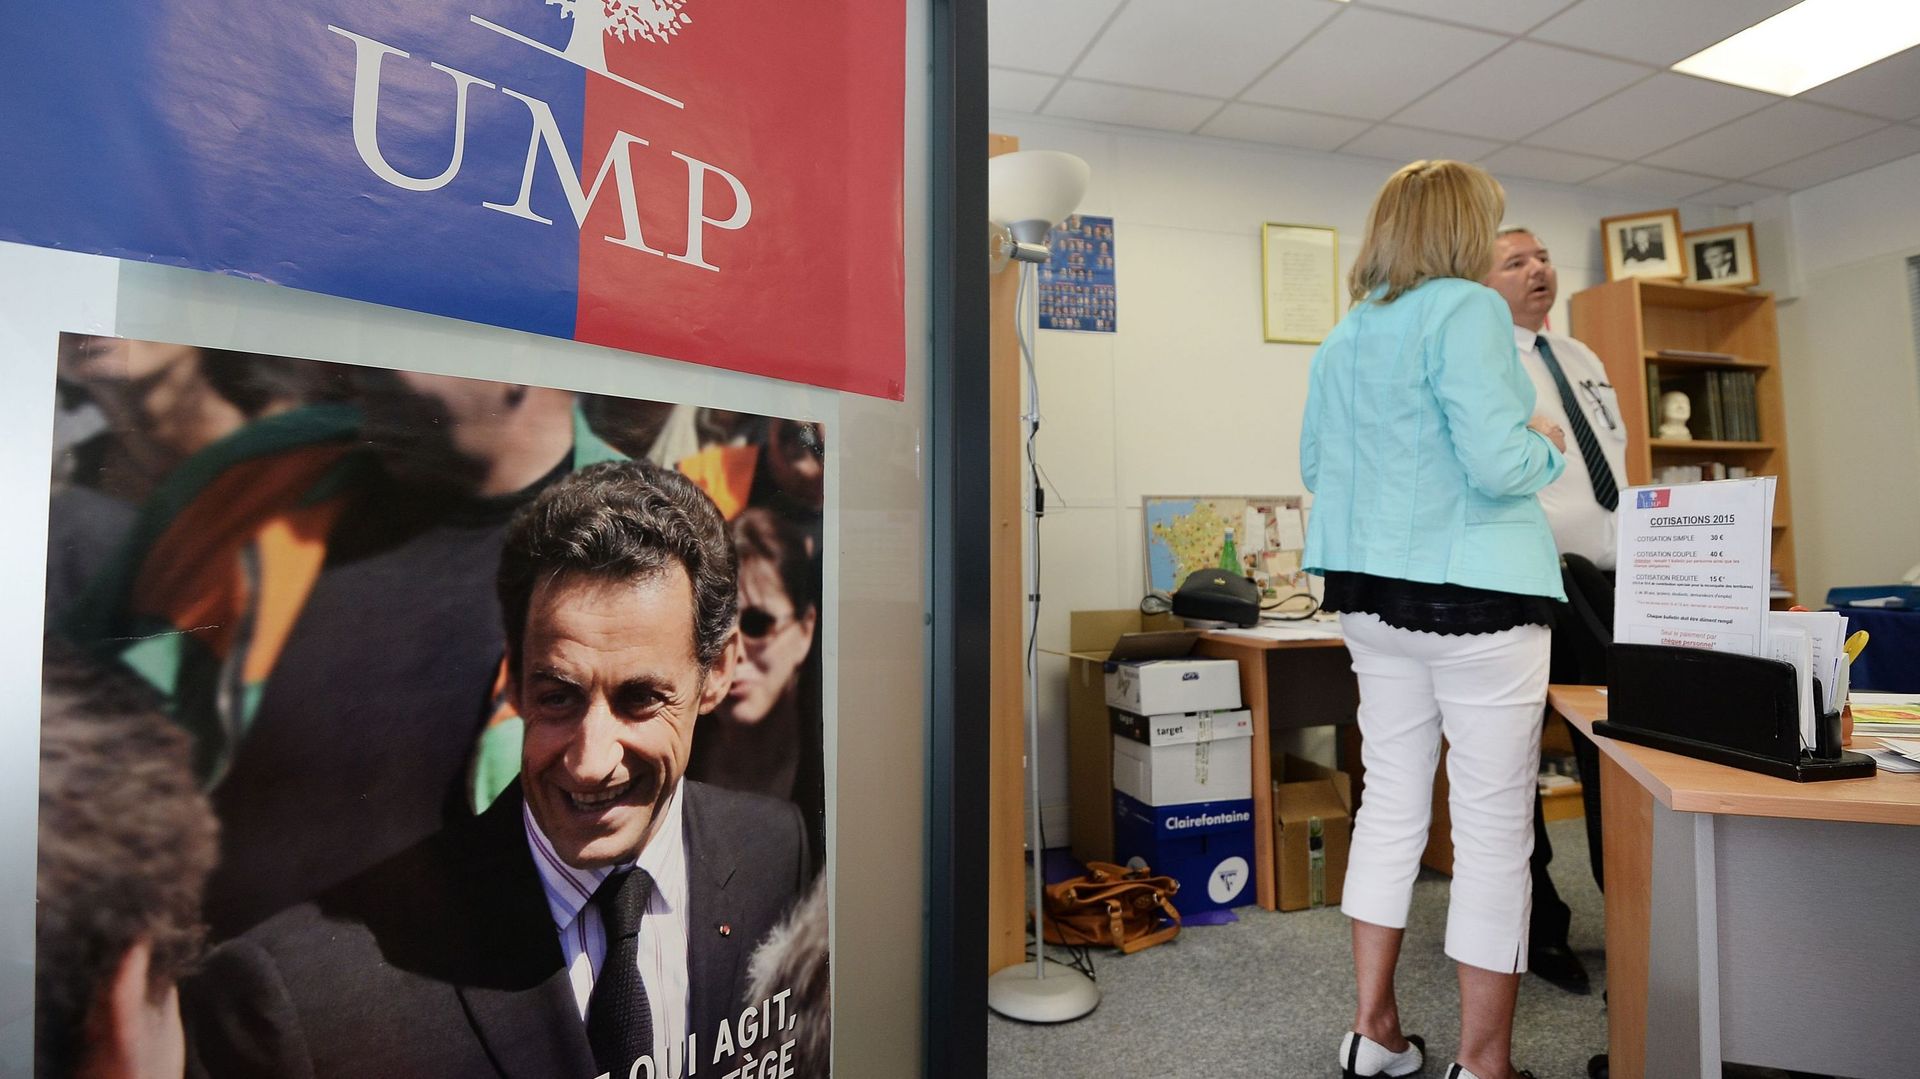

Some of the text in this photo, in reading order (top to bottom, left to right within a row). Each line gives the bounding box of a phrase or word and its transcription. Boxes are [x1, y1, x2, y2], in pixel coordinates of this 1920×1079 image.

[328, 24, 752, 272] UMP
[1650, 514, 1735, 526] COTISATIONS 2015
[1157, 726, 1183, 736] target
[1165, 810, 1250, 830] Clairefontaine
[712, 988, 797, 1064] AGIT,
